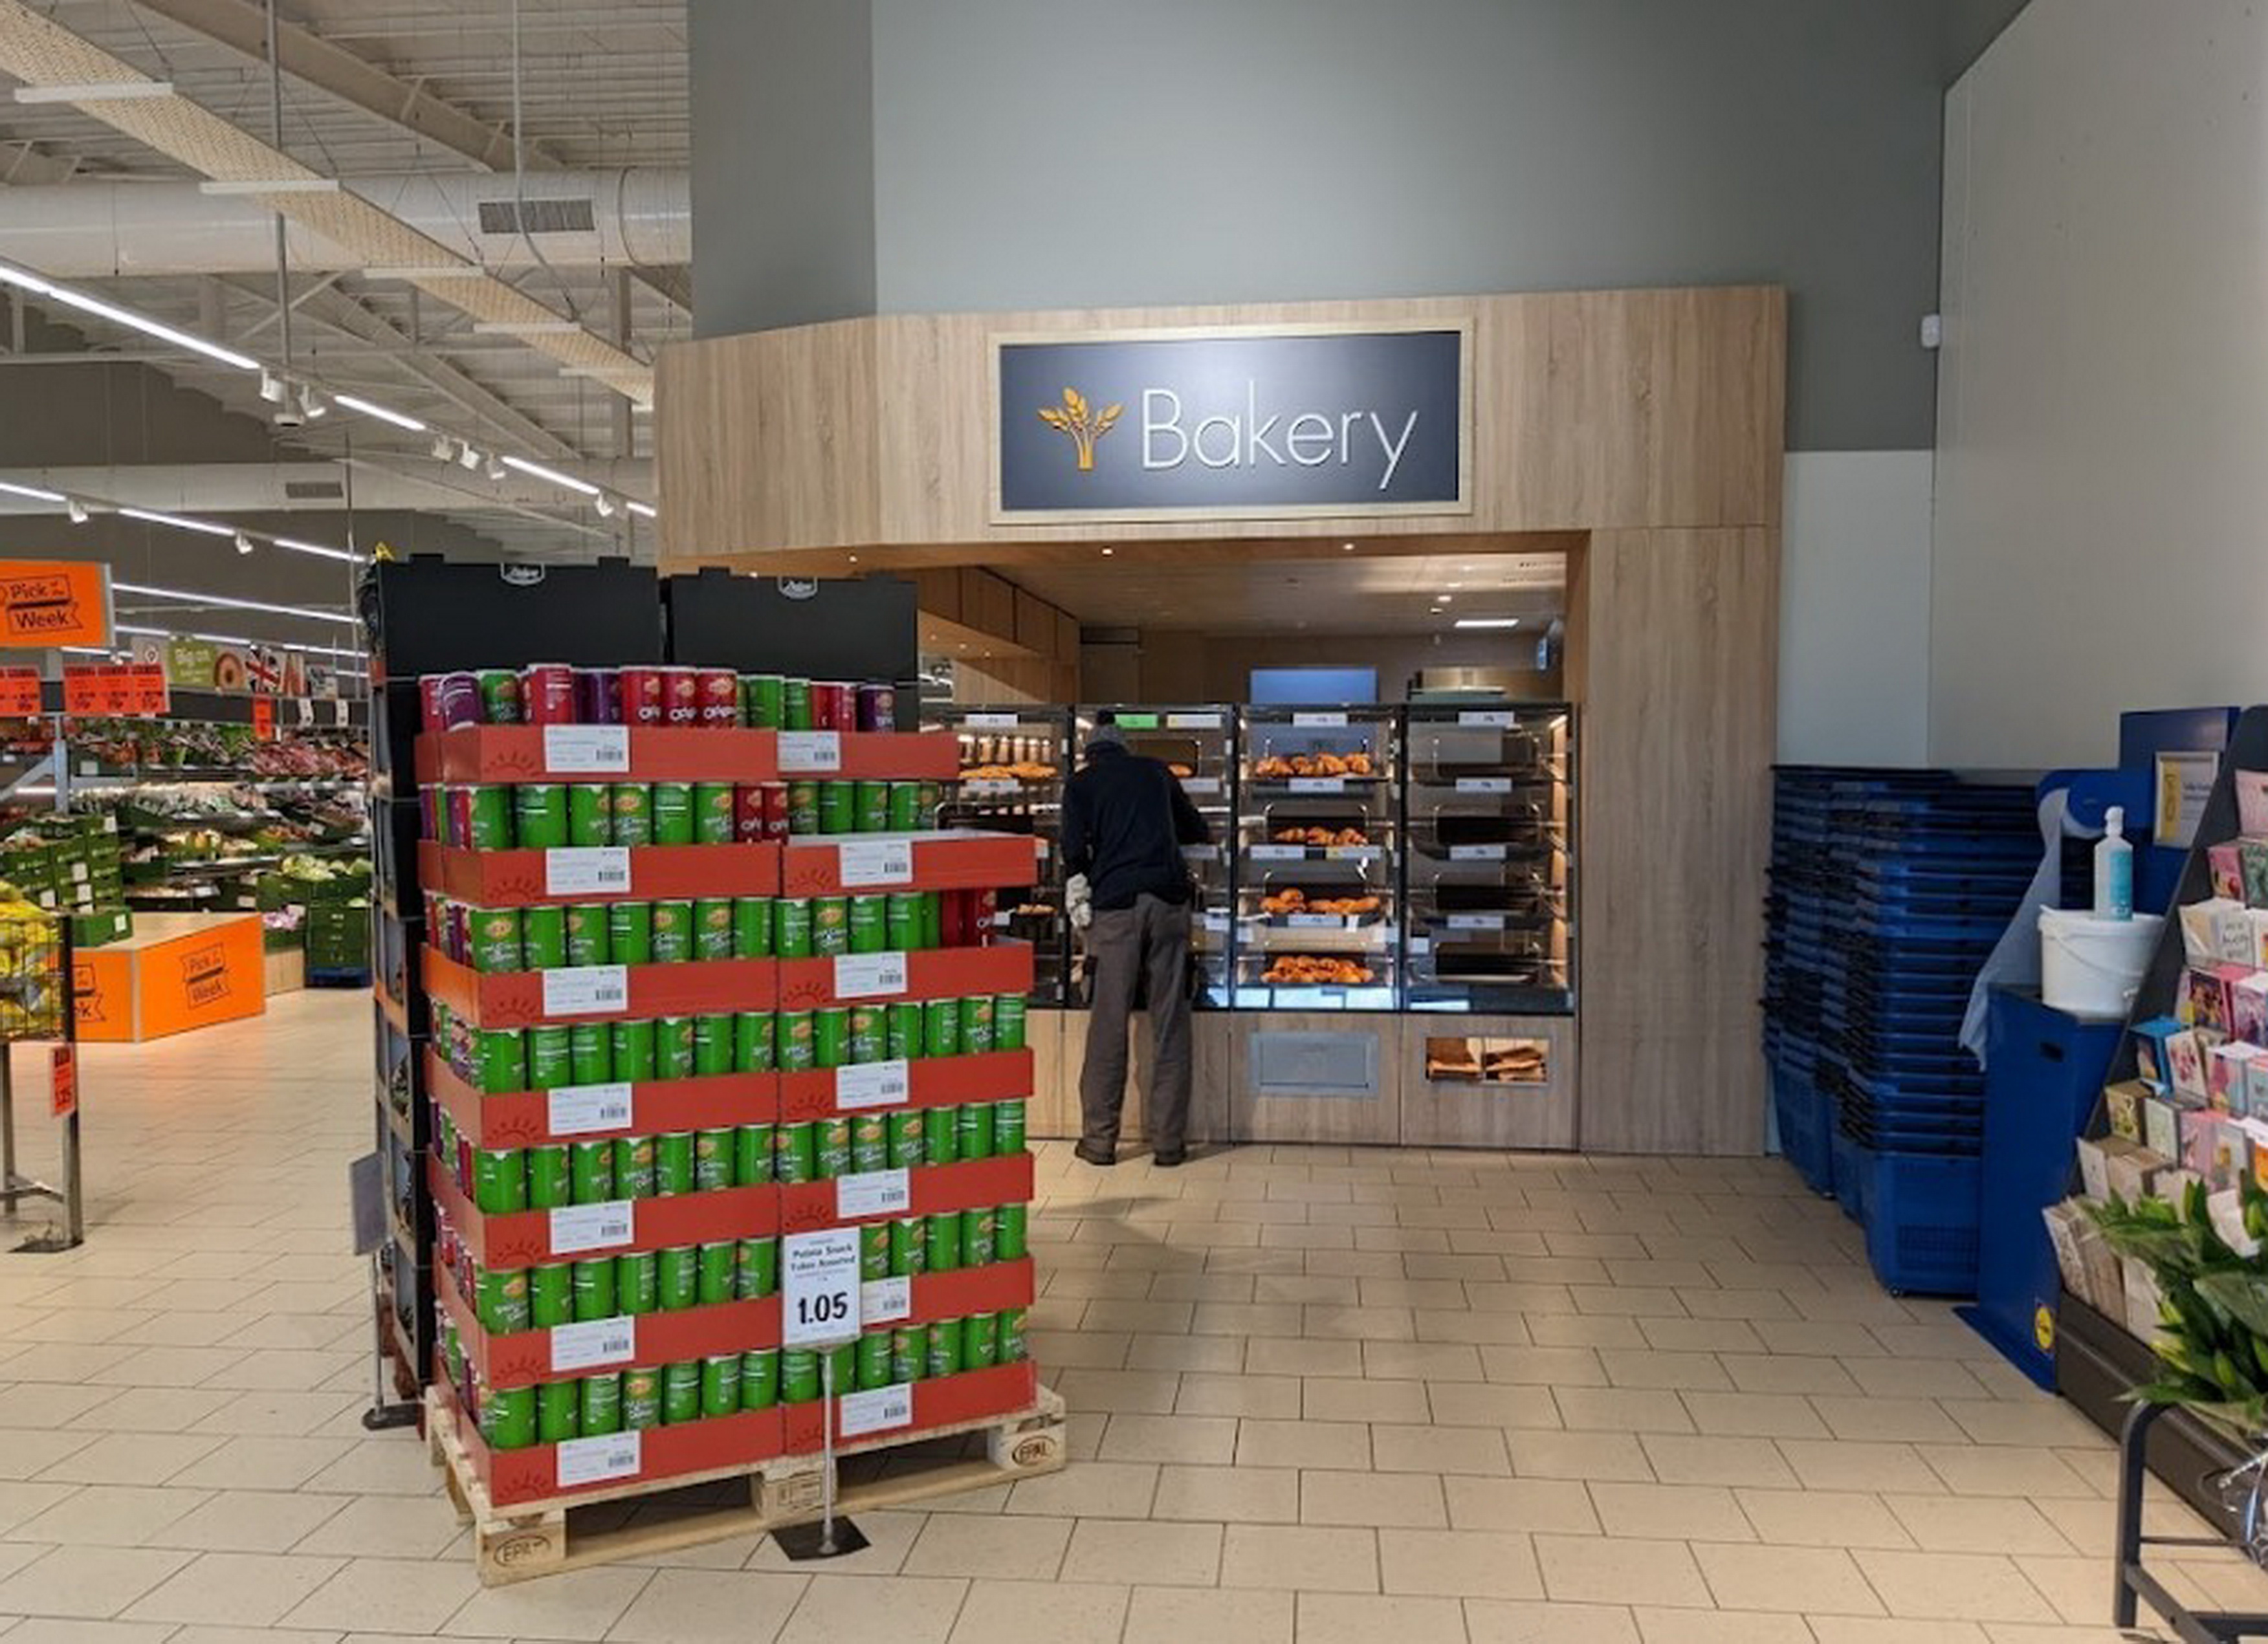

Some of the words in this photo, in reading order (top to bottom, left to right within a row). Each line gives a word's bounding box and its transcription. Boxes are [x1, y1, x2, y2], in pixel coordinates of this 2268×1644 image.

[1142, 379, 1418, 490] Bakery
[10, 582, 45, 599] Pick
[15, 609, 69, 628] Week
[797, 1291, 848, 1325] 1.05
